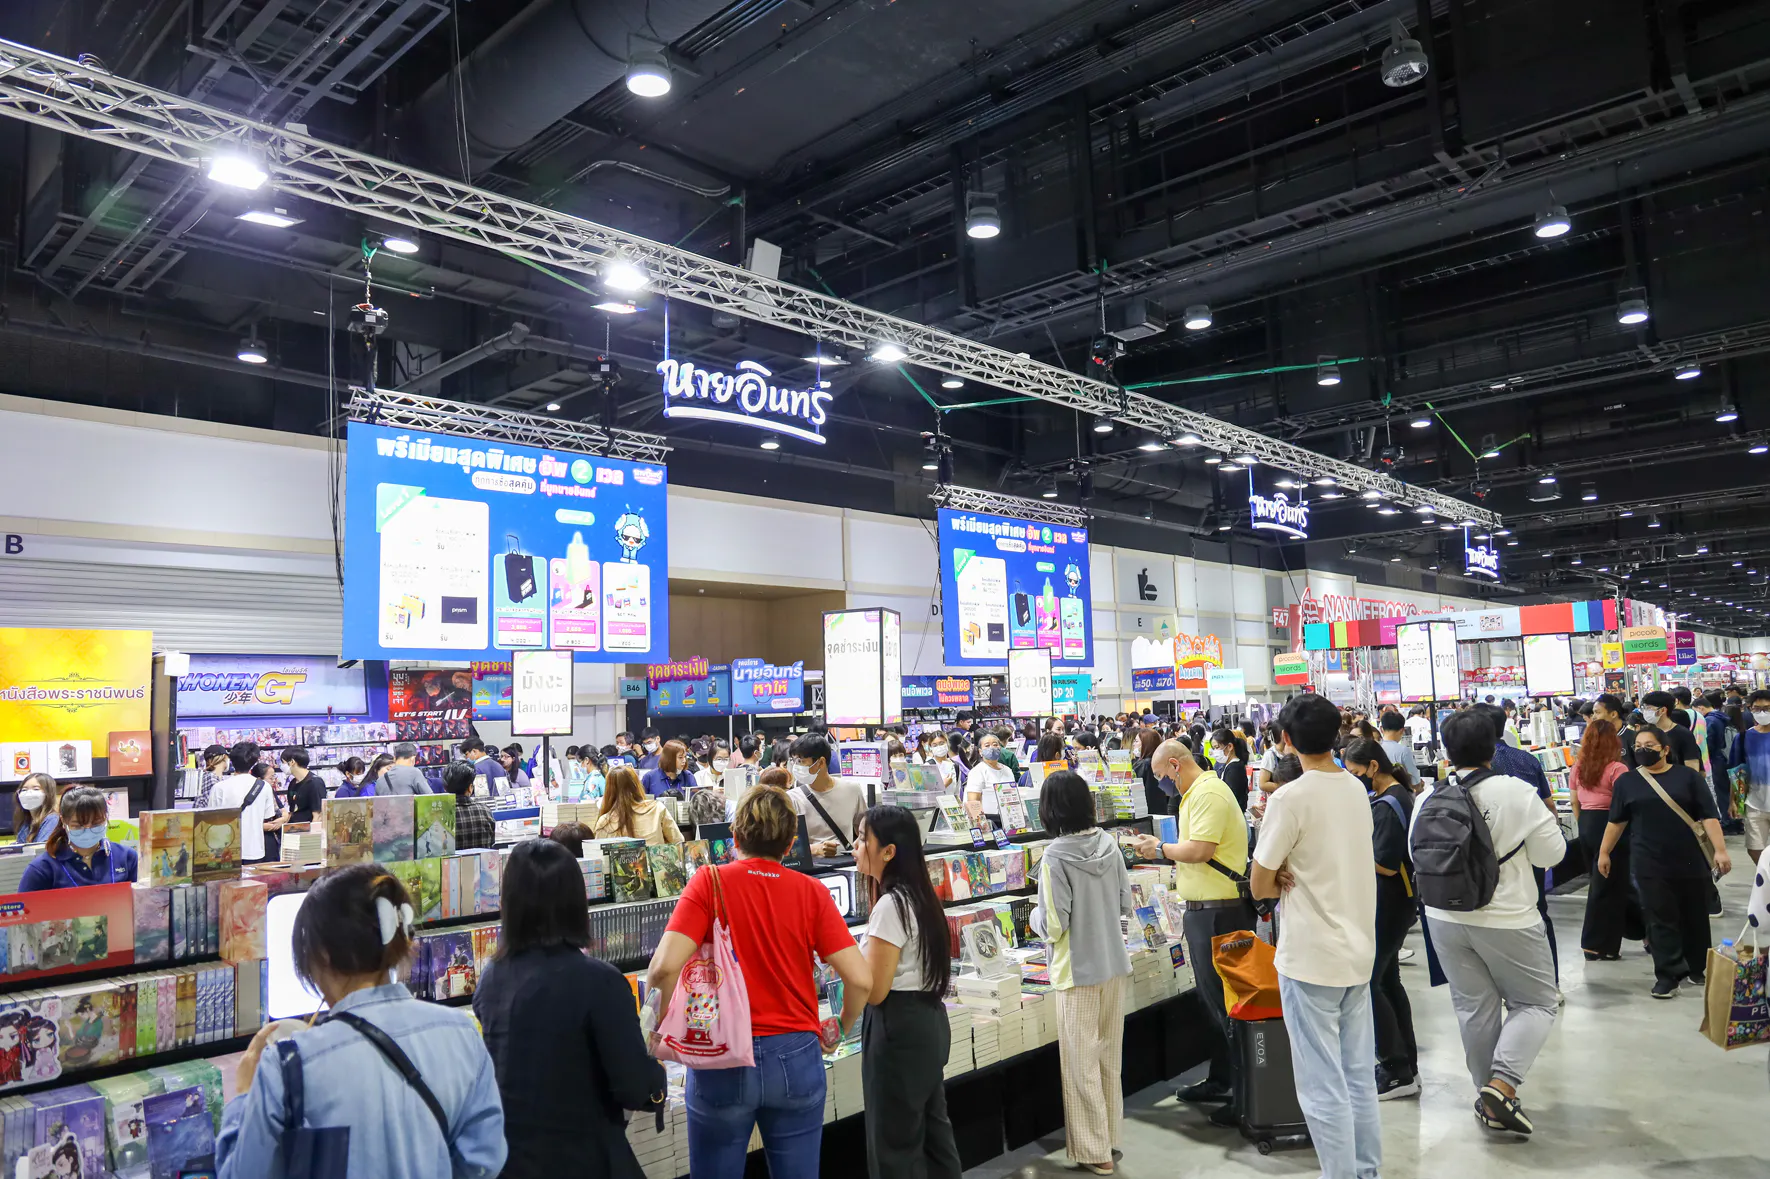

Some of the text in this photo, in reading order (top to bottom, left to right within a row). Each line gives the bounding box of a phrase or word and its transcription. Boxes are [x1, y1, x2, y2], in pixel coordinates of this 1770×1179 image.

[657, 359, 833, 424] นายอินทร์
[576, 463, 588, 479] 2
[1043, 529, 1050, 541] 2
[5, 534, 24, 554] B
[932, 604, 939, 616] D
[1137, 617, 1142, 627] E
[1273, 611, 1289, 627] F47
[827, 637, 879, 659] จุดชำระเงิน
[1631, 640, 1660, 649] words
[1678, 652, 1695, 660] Lilac
[734, 661, 804, 681] นายอินทร์
[255, 671, 307, 704] GT
[522, 670, 563, 690] มังงะ
[1014, 676, 1047, 693] ฮาวทู
[754, 681, 787, 696] หาให้
[1065, 687, 1074, 698] 20
[223, 692, 252, 704] 少年
[444, 708, 468, 720] IV
[1256, 1032, 1265, 1065] EVOA
